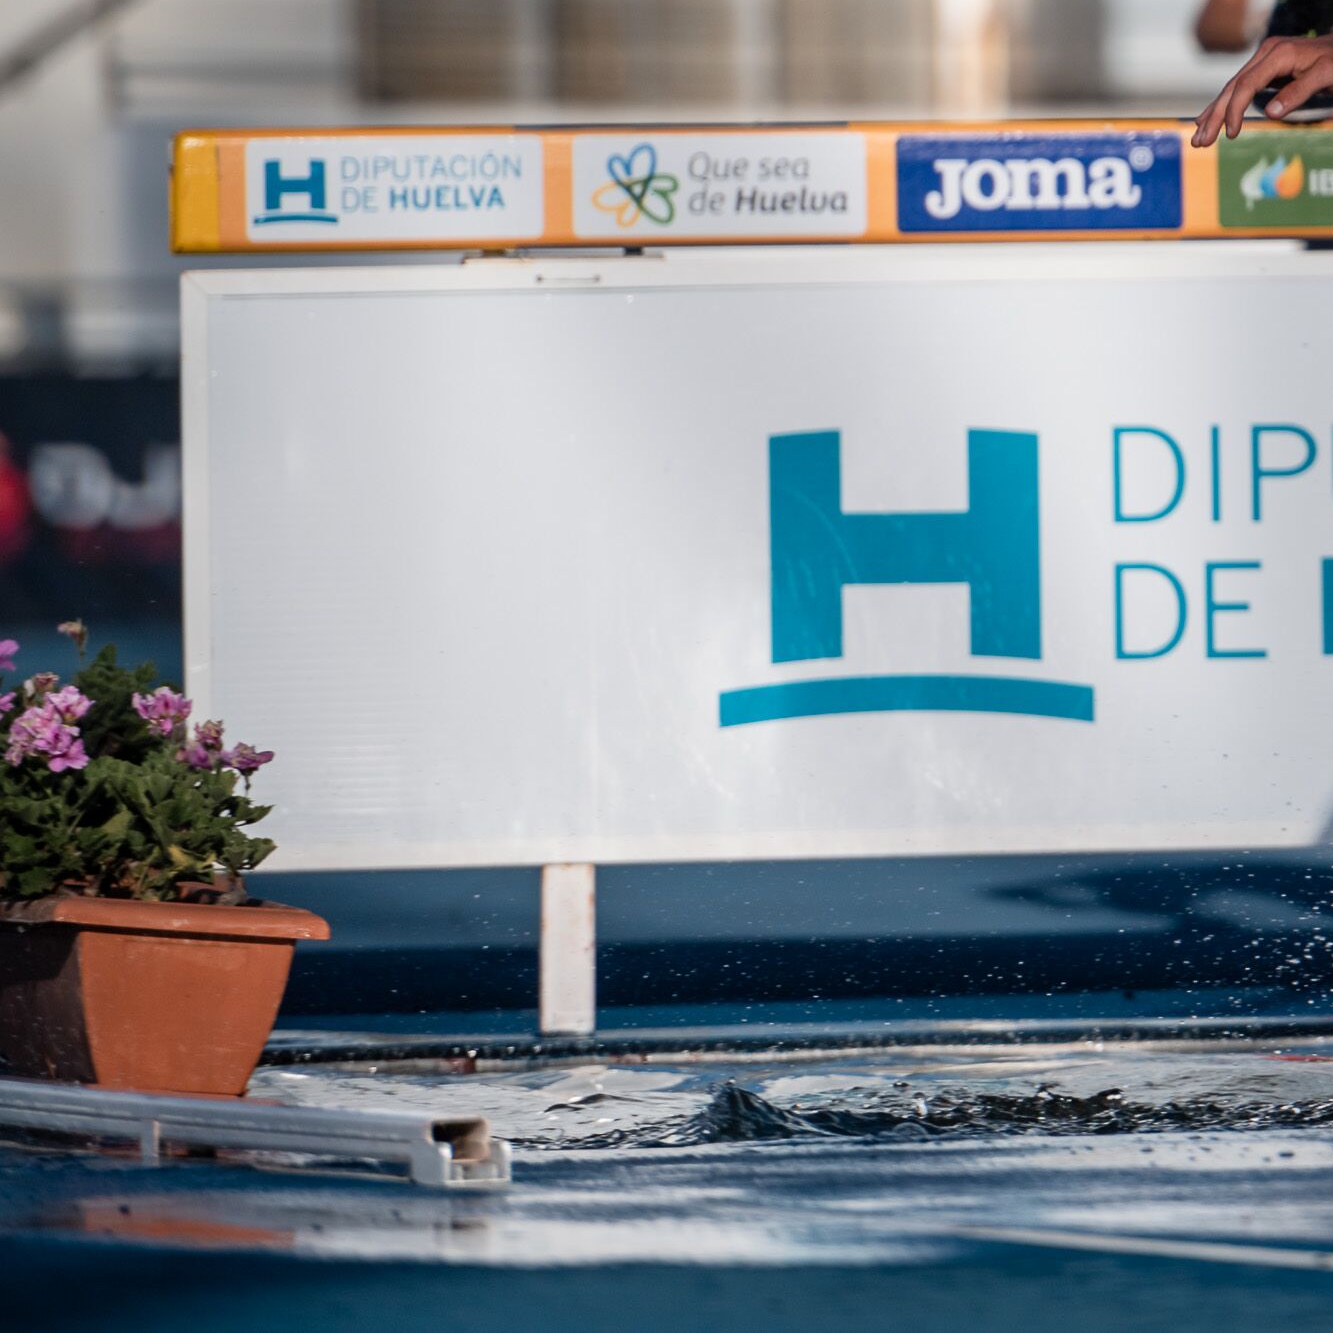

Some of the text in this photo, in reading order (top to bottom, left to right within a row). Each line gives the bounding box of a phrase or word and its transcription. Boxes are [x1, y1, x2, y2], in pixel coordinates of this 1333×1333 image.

[340, 151, 523, 183] DIPUTACIÓN
[687, 151, 812, 183] Que sea
[341, 184, 505, 213] DE HUELVA
[687, 184, 849, 214] de Huelva
[1114, 561, 1269, 660] DE
